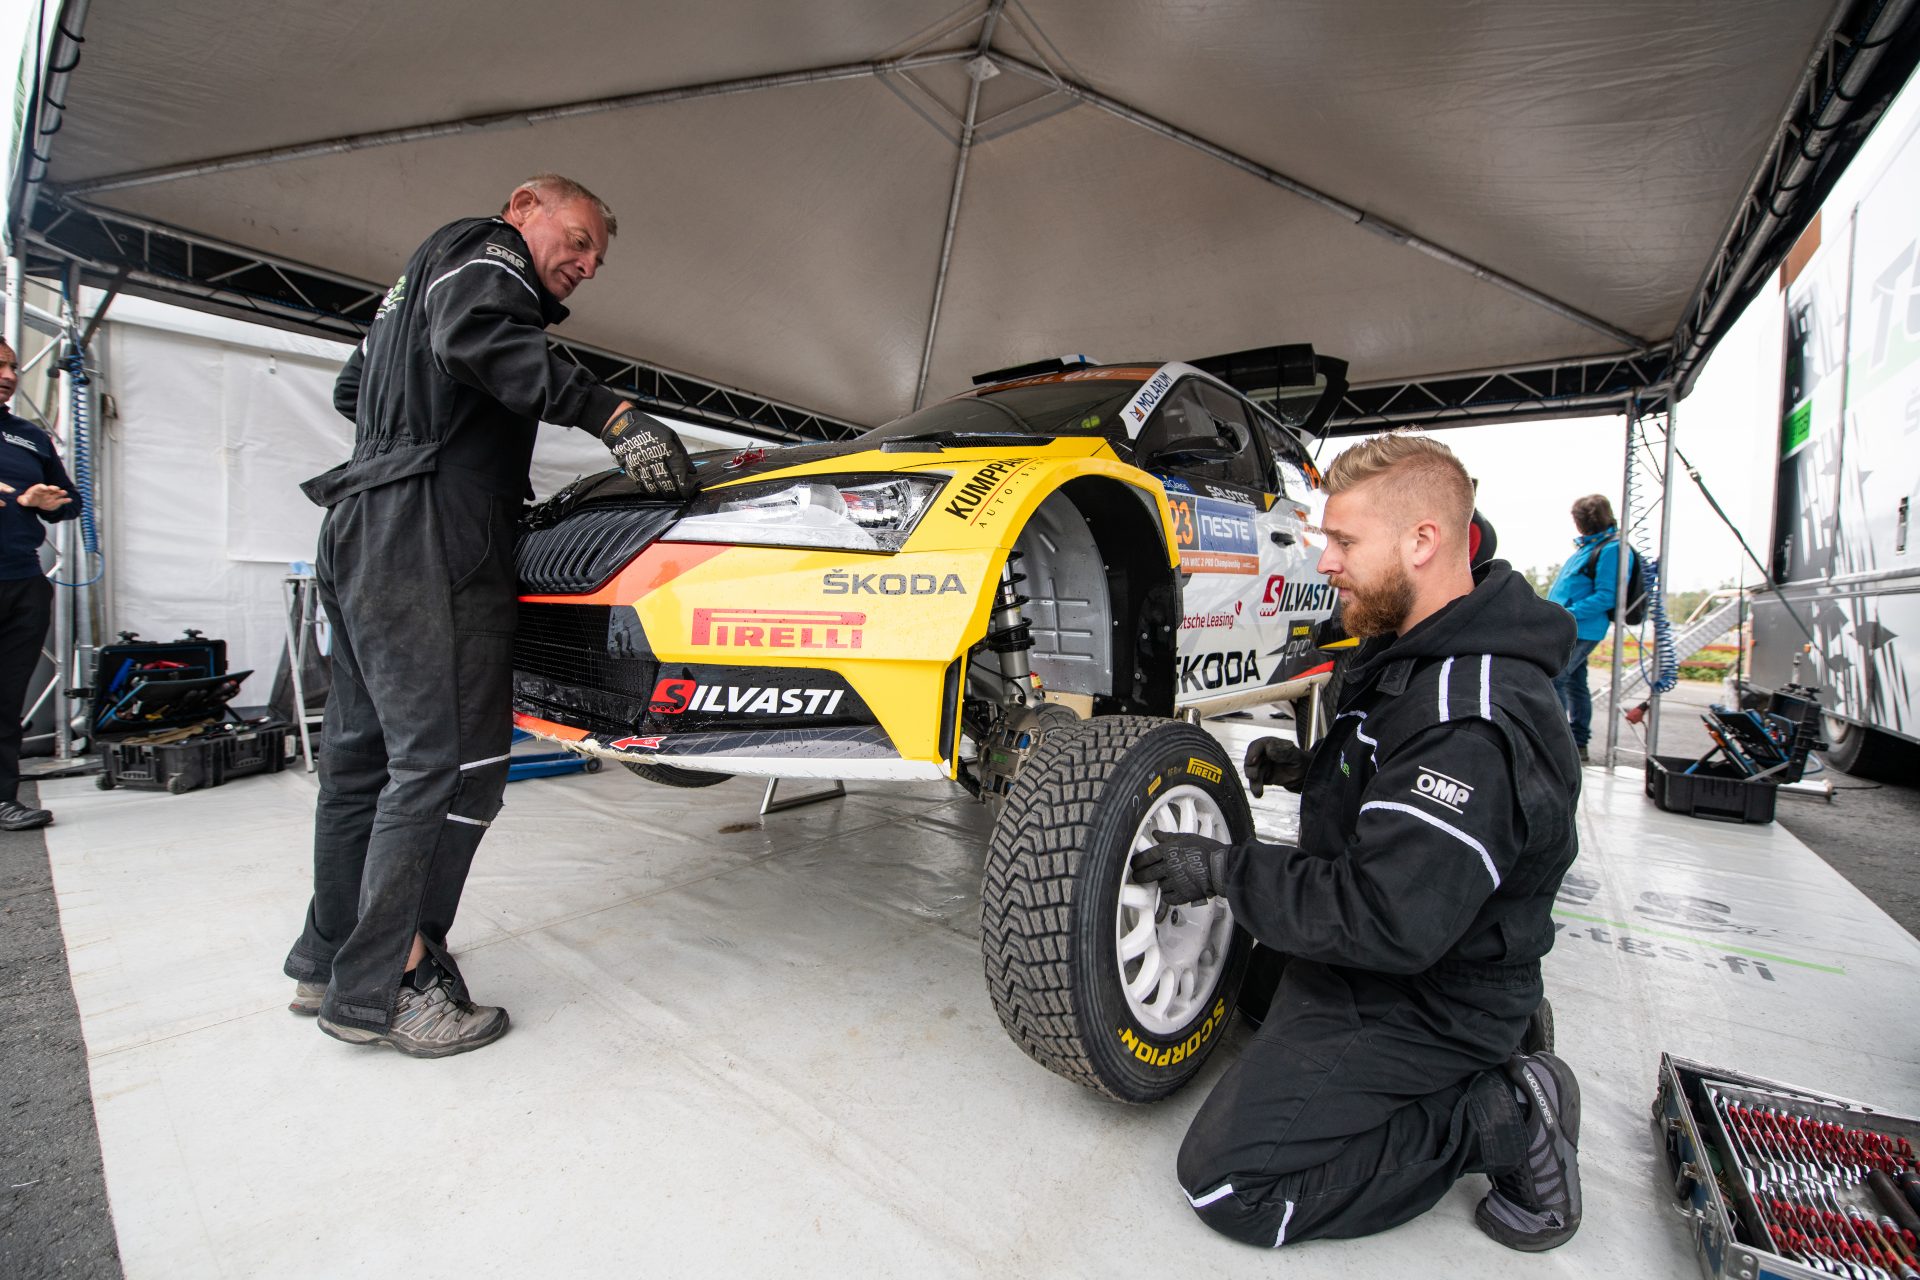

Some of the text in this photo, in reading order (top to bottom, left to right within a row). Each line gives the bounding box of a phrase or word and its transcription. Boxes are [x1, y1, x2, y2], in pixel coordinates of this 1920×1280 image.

[486, 246, 525, 269] OMP
[1136, 371, 1173, 412] MOLARUM
[1168, 500, 1194, 545] 23
[823, 568, 967, 595] ŠKODA
[1260, 575, 1335, 616] SILVASTI
[691, 608, 867, 649] PIRELLI
[1183, 611, 1234, 629] tsche Leasing
[649, 679, 844, 715] SILVASTI
[1186, 757, 1223, 784] PIRELLI
[1416, 774, 1470, 806] OMP
[1555, 922, 1776, 982] .tgs.fi
[1121, 998, 1226, 1067] SCORPION
[1526, 1073, 1554, 1125] salomon
